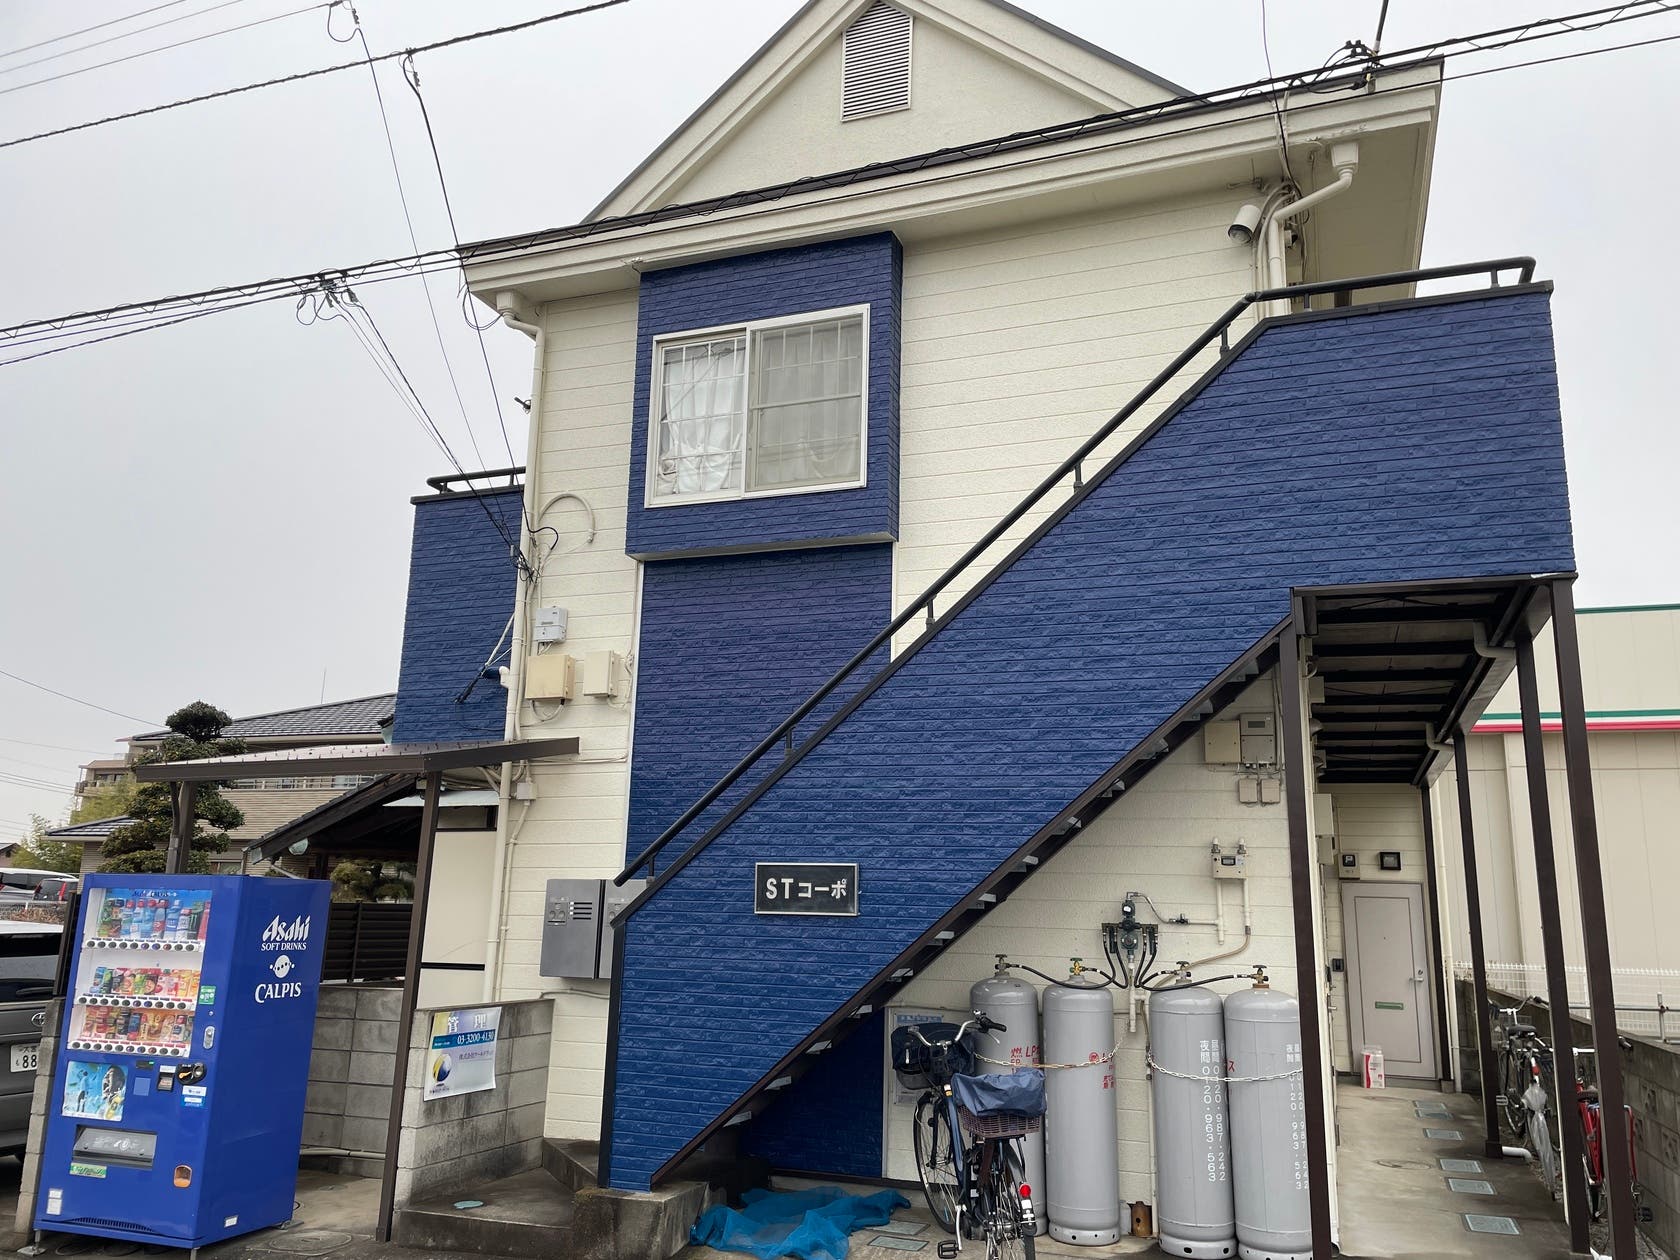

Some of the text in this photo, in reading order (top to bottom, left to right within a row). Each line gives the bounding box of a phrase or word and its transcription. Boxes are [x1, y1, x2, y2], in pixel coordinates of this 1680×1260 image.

[765, 877, 847, 900] STコーポ
[262, 915, 311, 942] Asahi
[261, 942, 307, 951] SOFT DRINKS
[255, 982, 302, 1004] CALPIS
